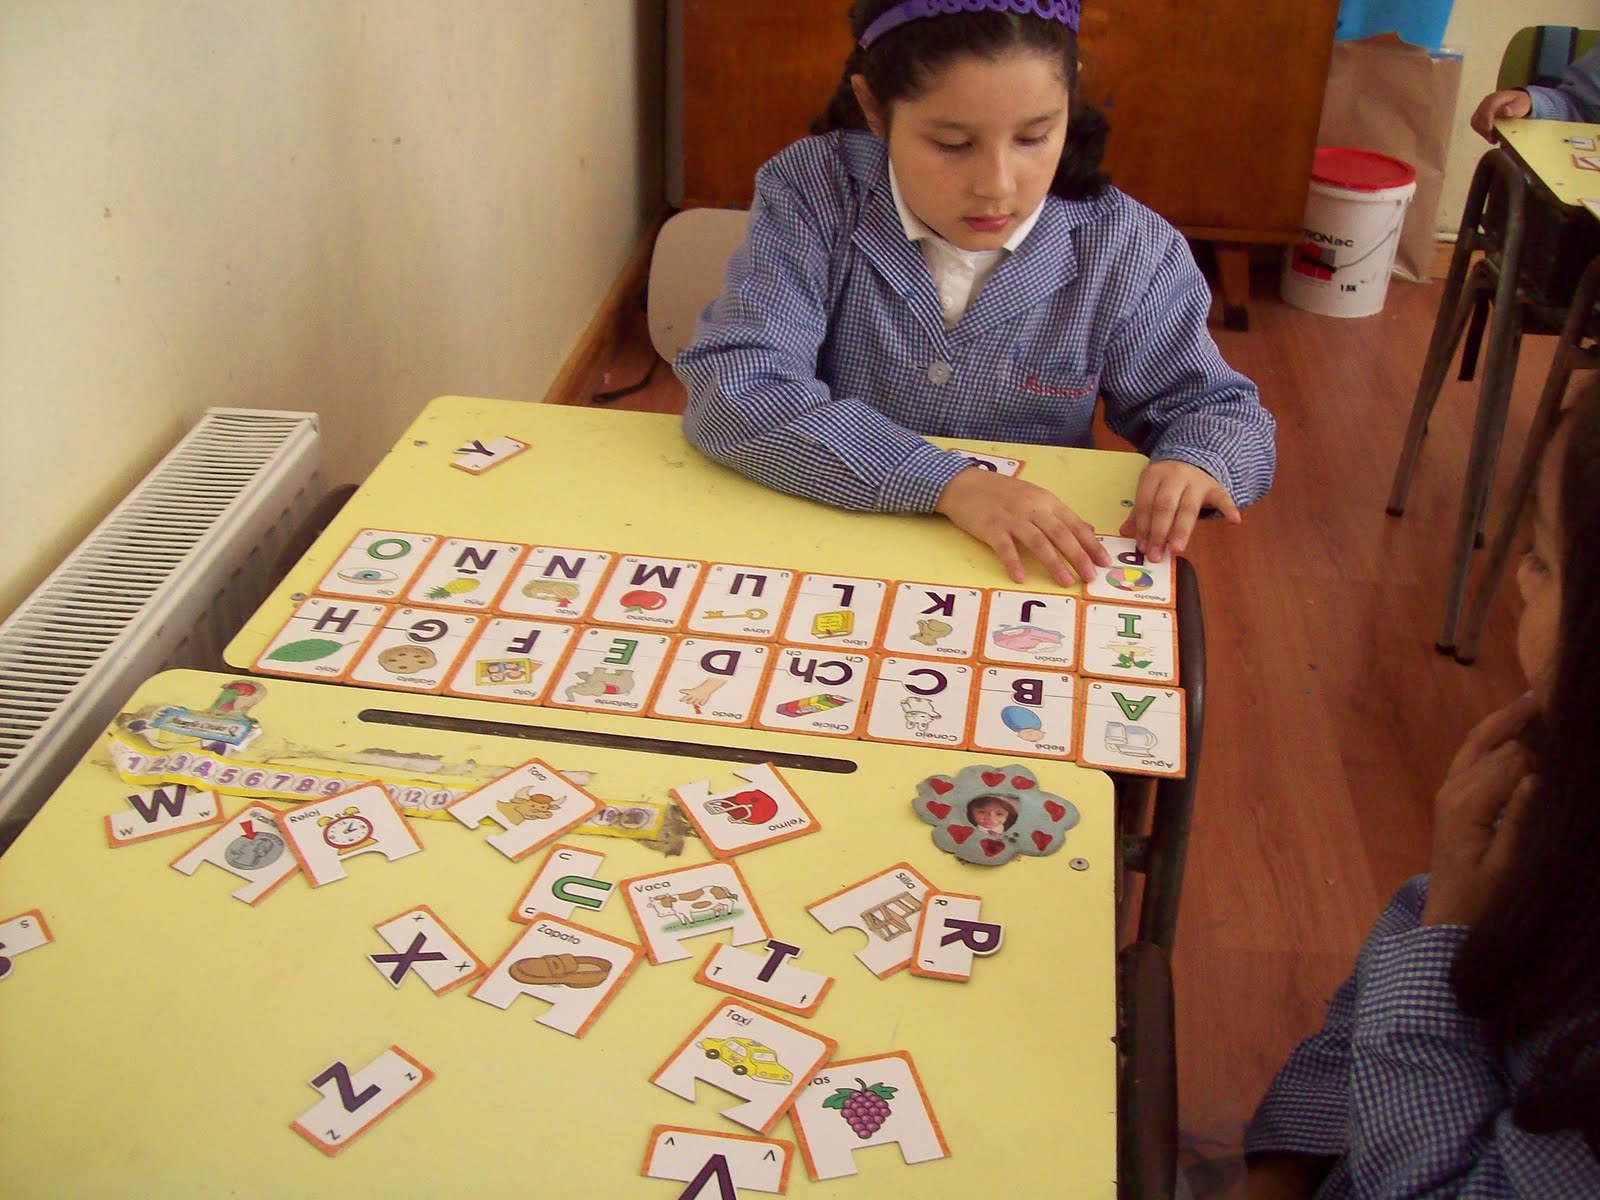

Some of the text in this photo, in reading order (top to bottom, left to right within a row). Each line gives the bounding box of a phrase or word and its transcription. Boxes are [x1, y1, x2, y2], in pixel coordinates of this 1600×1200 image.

[458, 440, 495, 456] Y
[367, 538, 411, 560] O
[1117, 545, 1145, 566] P
[543, 555, 586, 579] N
[630, 563, 681, 589] M
[832, 583, 855, 607] L
[921, 591, 957, 616] K
[313, 607, 358, 633] H
[625, 614, 674, 626] Manzana
[1020, 600, 1047, 623] J
[410, 619, 448, 642] G
[1118, 612, 1142, 639] I
[506, 630, 540, 654] F
[604, 638, 638, 665] E
[936, 647, 968, 656] Koala
[700, 649, 741, 676] D
[789, 657, 853, 685] Ch
[396, 675, 436, 686] Galleta
[905, 668, 948, 695] C
[1012, 679, 1043, 705] B
[594, 698, 639, 709] Elefante
[711, 710, 742, 720] Dedo
[1111, 691, 1156, 720] A
[812, 721, 849, 731] Chicle
[915, 731, 957, 742] Conejo
[1141, 759, 1173, 769] Agua
[128, 757, 140, 770] 1
[219, 769, 238, 783] 5
[245, 772, 263, 786] 6
[272, 775, 290, 789] 7
[296, 778, 314, 793] 8
[322, 781, 341, 797] 9
[404, 790, 422, 803] 12
[127, 783, 188, 823] W
[288, 809, 320, 823] Reloj
[768, 818, 806, 832] Yelmo
[551, 875, 612, 908] U
[634, 880, 671, 893] Vaca
[895, 872, 916, 889] Silla
[537, 923, 580, 944] Zapato
[940, 918, 1002, 952] R
[370, 931, 447, 985] X
[757, 940, 801, 982] T
[725, 1008, 753, 1027] Taxi
[311, 1061, 382, 1113] Z
